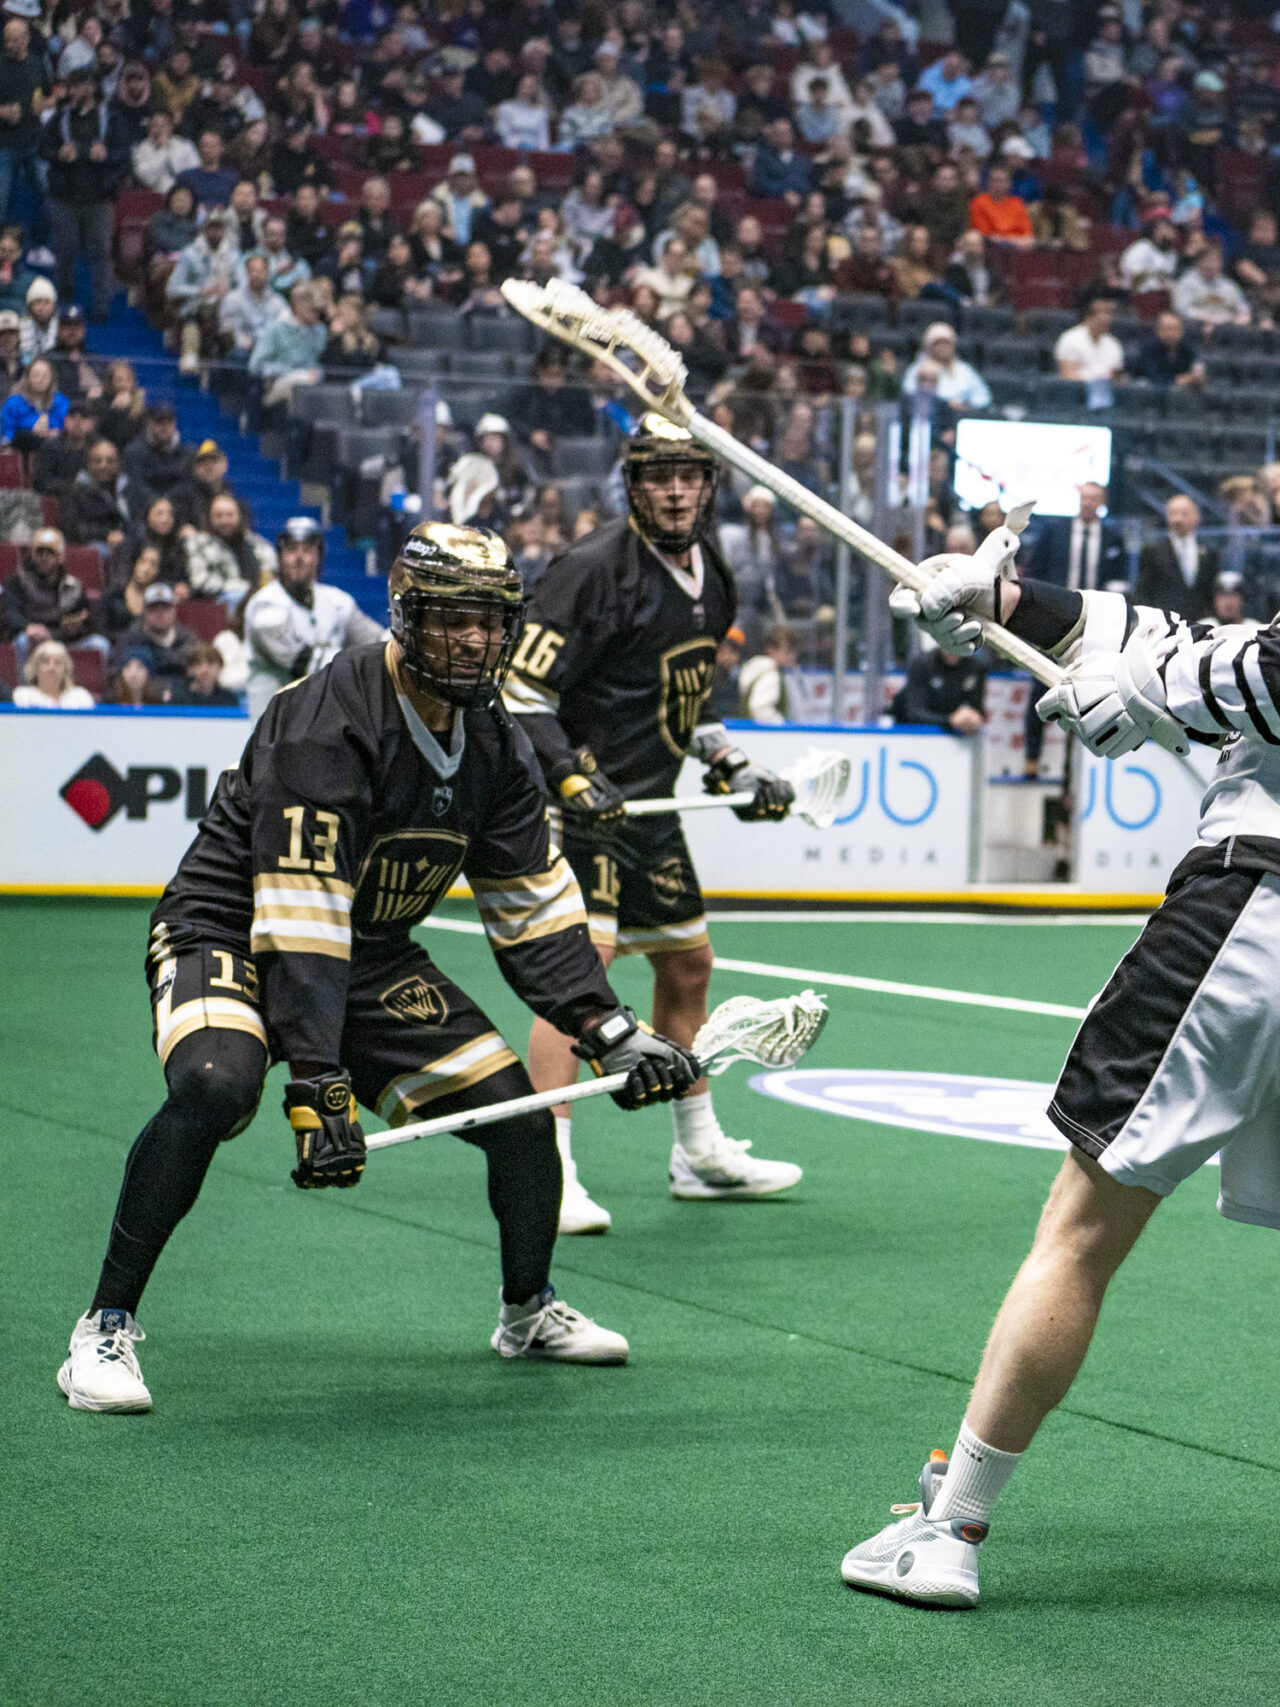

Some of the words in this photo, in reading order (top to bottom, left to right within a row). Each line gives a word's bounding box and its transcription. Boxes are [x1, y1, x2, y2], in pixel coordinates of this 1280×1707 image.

[511, 622, 566, 679] 16
[278, 806, 341, 873] 13
[806, 846, 939, 865] MEDIA
[1097, 852, 1162, 868] DIA
